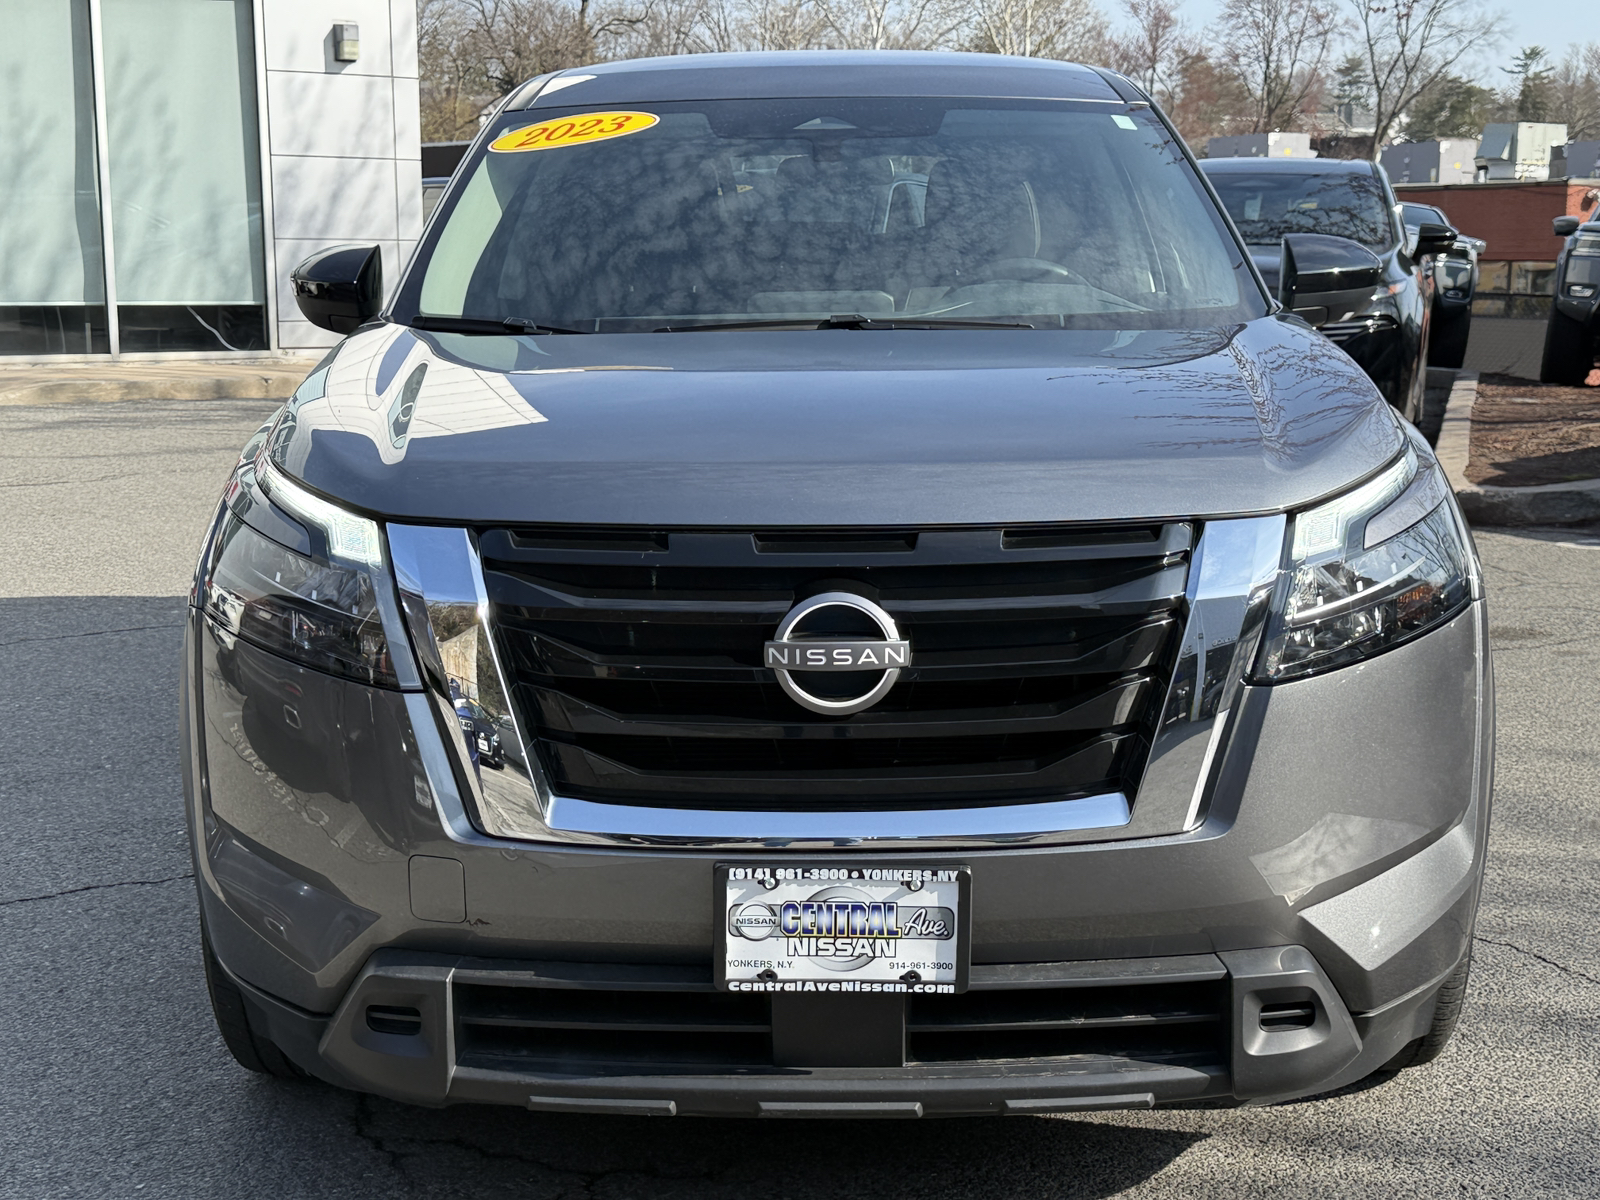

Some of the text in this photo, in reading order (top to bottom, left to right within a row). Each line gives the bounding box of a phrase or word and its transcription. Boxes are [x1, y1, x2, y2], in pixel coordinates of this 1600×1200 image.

[514, 115, 632, 148] 2023
[768, 646, 905, 665] NISSAN
[775, 868, 849, 880] 961-3900
[780, 901, 950, 938] CENTRAL Ave.
[787, 937, 897, 958] NISSAN
[727, 960, 776, 969] YONKERS,
[888, 962, 953, 970] 914-961-3900
[728, 981, 955, 993] CentralAveNissan.com
